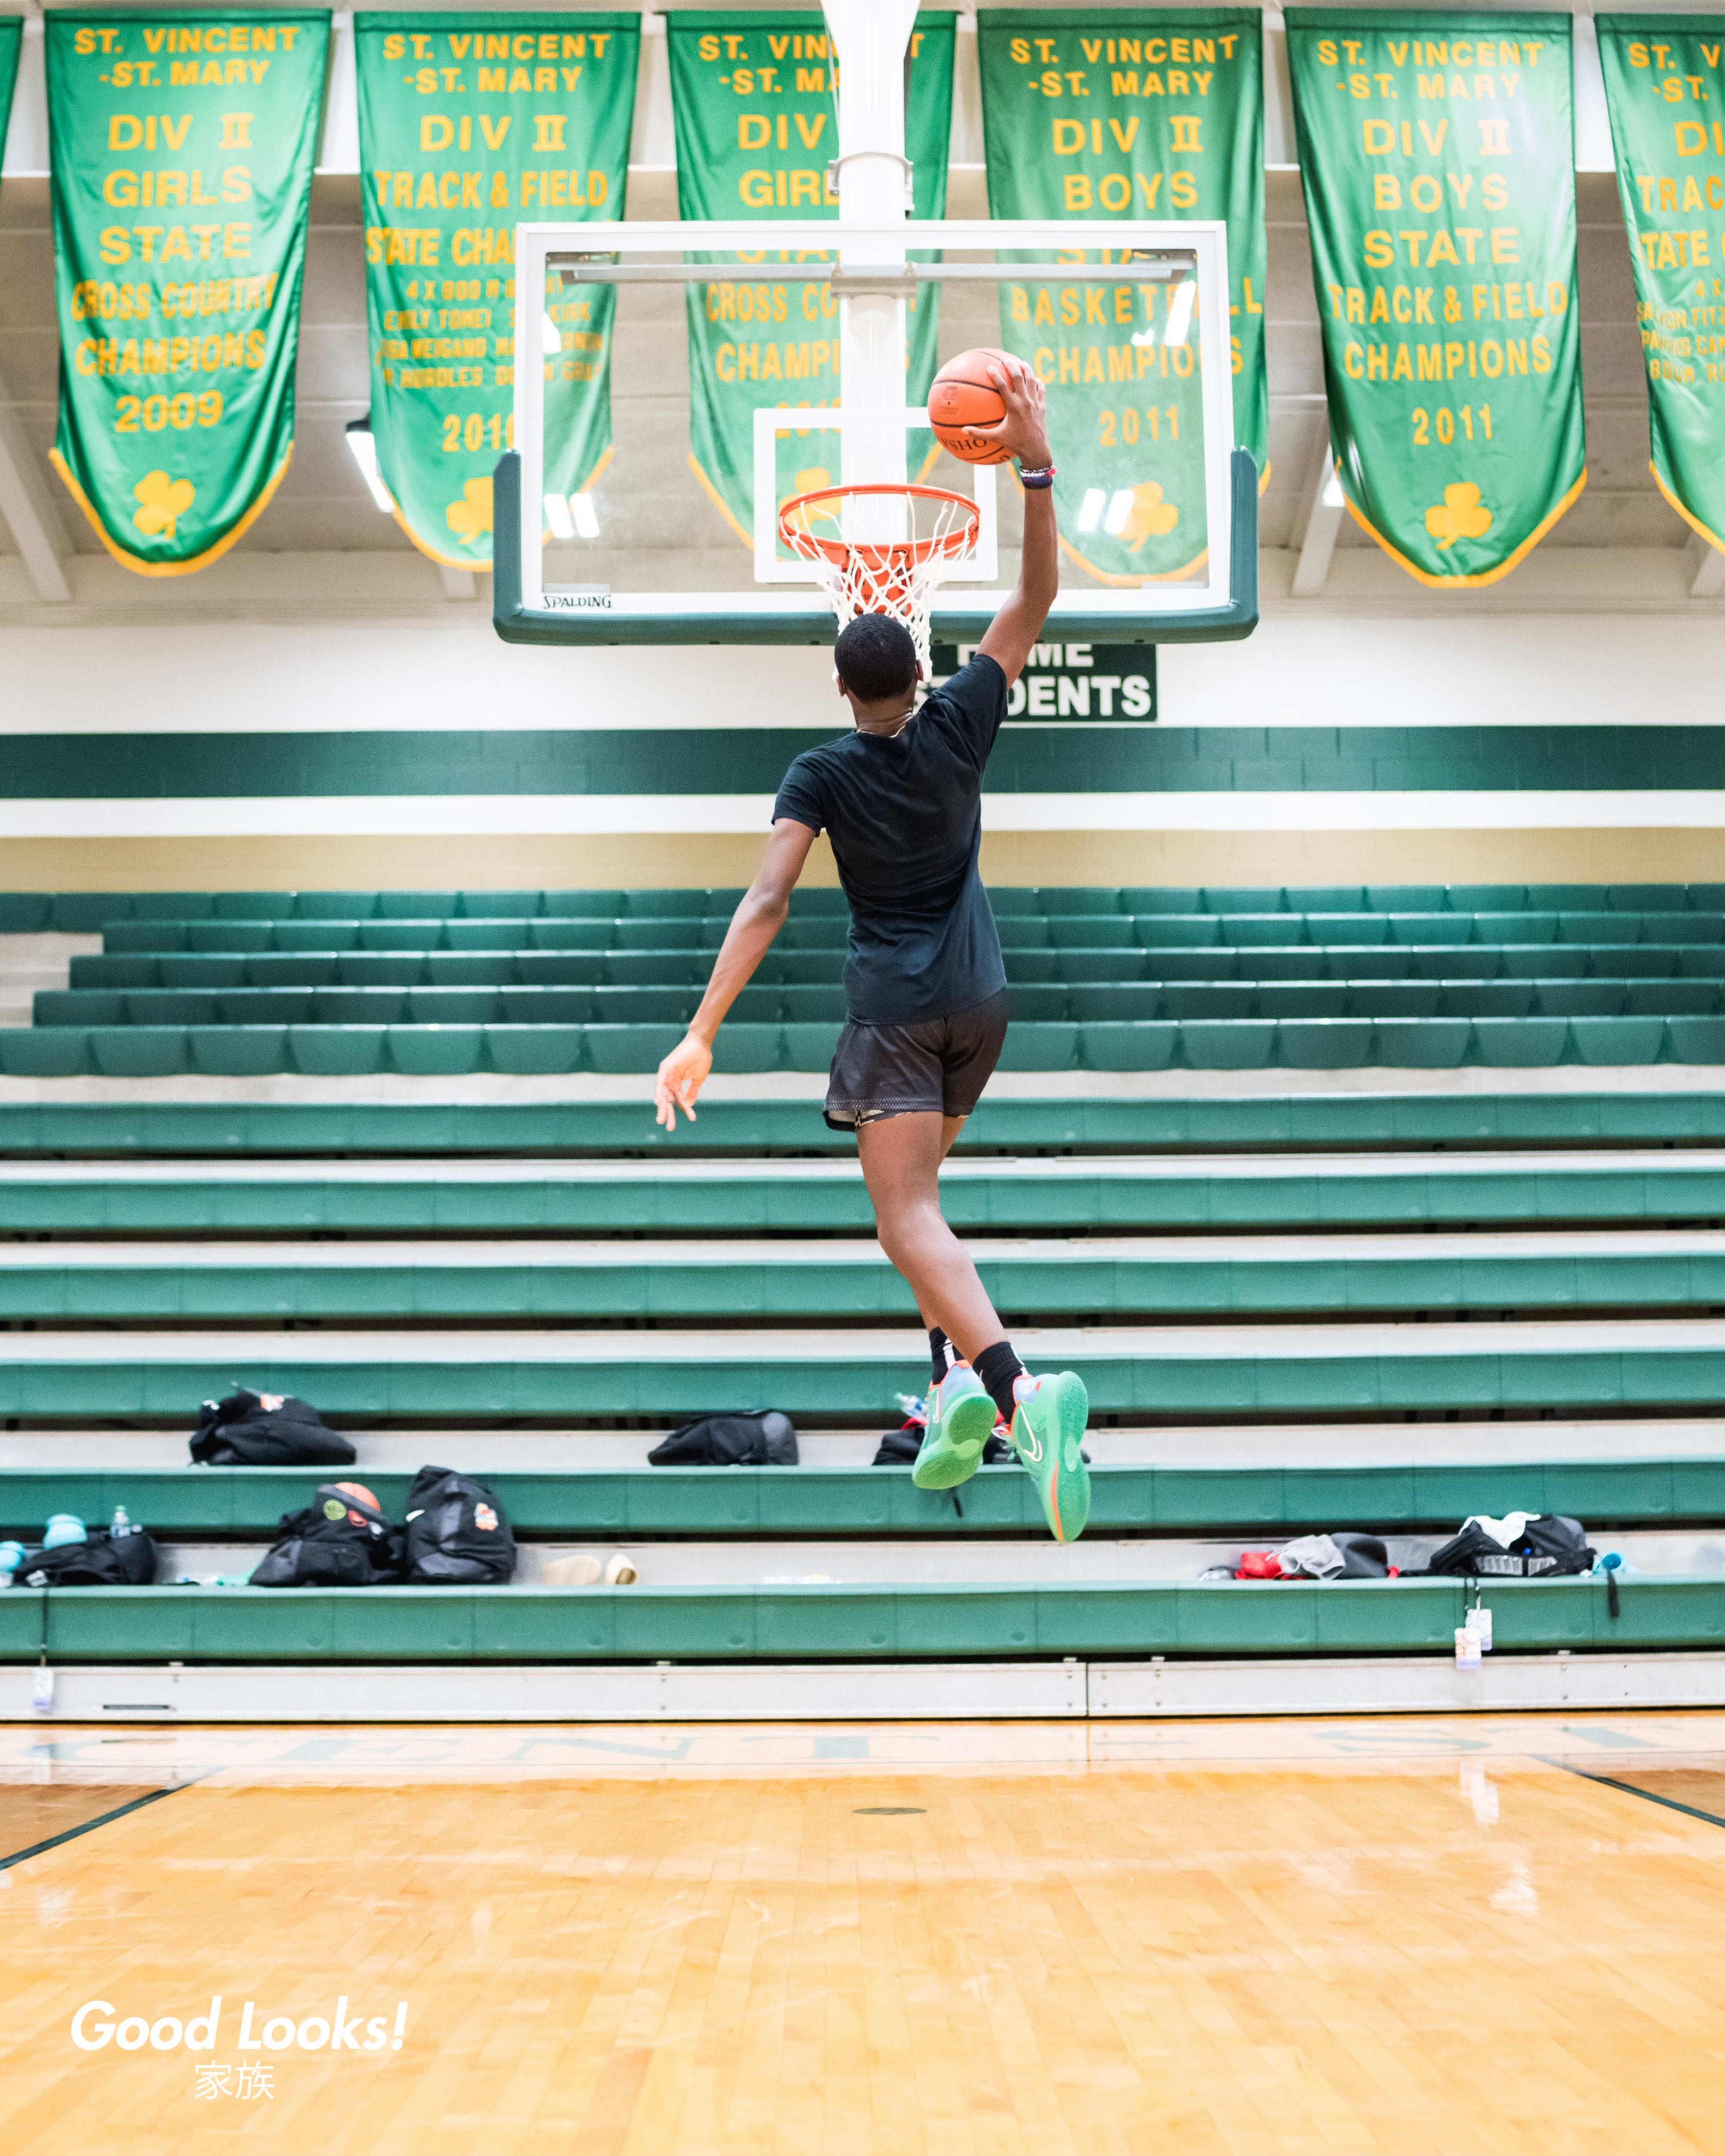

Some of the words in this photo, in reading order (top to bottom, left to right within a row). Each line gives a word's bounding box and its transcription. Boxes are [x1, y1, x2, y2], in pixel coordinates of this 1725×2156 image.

[75, 28, 123, 54] ST.
[143, 27, 300, 53] VINCENT
[383, 35, 434, 60] ST.
[449, 34, 610, 60] VINCENT
[699, 35, 748, 61] ST.
[1010, 38, 1059, 64] ST.
[1080, 34, 1238, 64] VINCENT
[1318, 40, 1366, 66] ST.
[1387, 40, 1544, 67] VINCENT
[1628, 42, 1676, 70] ST.
[99, 62, 161, 87] -ST.
[170, 60, 270, 85] MARY
[404, 67, 465, 94] -ST.
[478, 66, 582, 93] MARY
[719, 67, 783, 95] -ST.
[1028, 71, 1090, 97] -ST.
[1111, 71, 1213, 97] MARY
[1336, 73, 1398, 99] -ST.
[1417, 73, 1520, 99] MARY
[1653, 75, 1709, 103] -ST.
[108, 115, 193, 151] DIV
[219, 113, 254, 149] II
[420, 115, 511, 151] DIV
[533, 115, 567, 151] II
[738, 114, 827, 150] DIV
[1053, 117, 1140, 155] DIV
[1170, 115, 1203, 153] II
[1363, 119, 1448, 156] DIV
[1477, 119, 1511, 156] II
[103, 166, 252, 207] GIRLS
[375, 170, 482, 208] TRACK
[490, 171, 509, 208] &
[521, 170, 608, 208] FIELD
[1064, 171, 1198, 211] BOYS
[1374, 172, 1509, 212] BOYS
[99, 223, 252, 264] STATE
[1364, 227, 1520, 268] STATE
[1638, 230, 1711, 270] TATE
[71, 280, 151, 320] CROSS
[161, 273, 278, 319] COUNTRY
[406, 280, 418, 300] 4
[424, 280, 436, 300] X
[442, 279, 481, 300] 800
[706, 283, 788, 323] CROSS
[1328, 283, 1435, 324] TRACK
[1443, 285, 1463, 324] &
[1472, 281, 1568, 320] FIELD
[75, 330, 266, 376] CHAMPIONS
[1035, 336, 1243, 384] CHAMPIOS
[1345, 336, 1552, 381] CHAMPIONS
[115, 390, 223, 432] 2009
[1099, 405, 1179, 446] 2011
[1412, 404, 1492, 445] 2011
[544, 595, 611, 609] SPALDING
